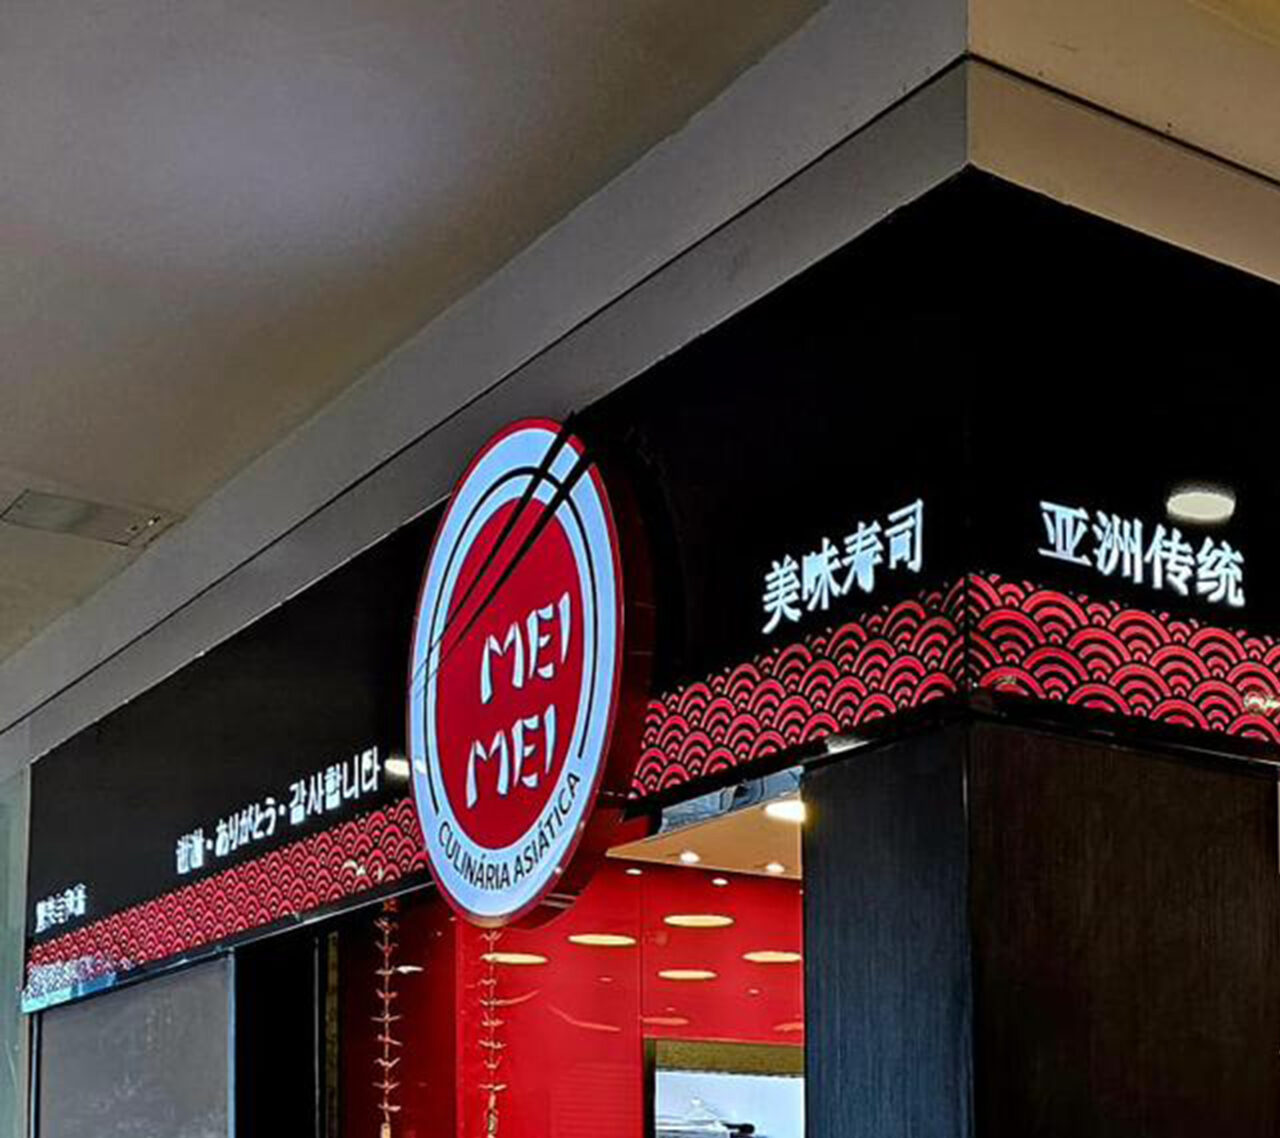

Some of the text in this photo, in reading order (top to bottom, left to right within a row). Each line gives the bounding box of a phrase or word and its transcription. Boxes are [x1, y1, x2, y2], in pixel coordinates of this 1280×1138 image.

[762, 499, 923, 634] 美味寿司
[1039, 500, 1246, 607] 亚洲传统
[480, 591, 571, 704] MEI
[289, 746, 380, 825] 감사합니다
[466, 703, 557, 809] MEI
[438, 773, 581, 890] CULINÁRIA ASIÁTICA
